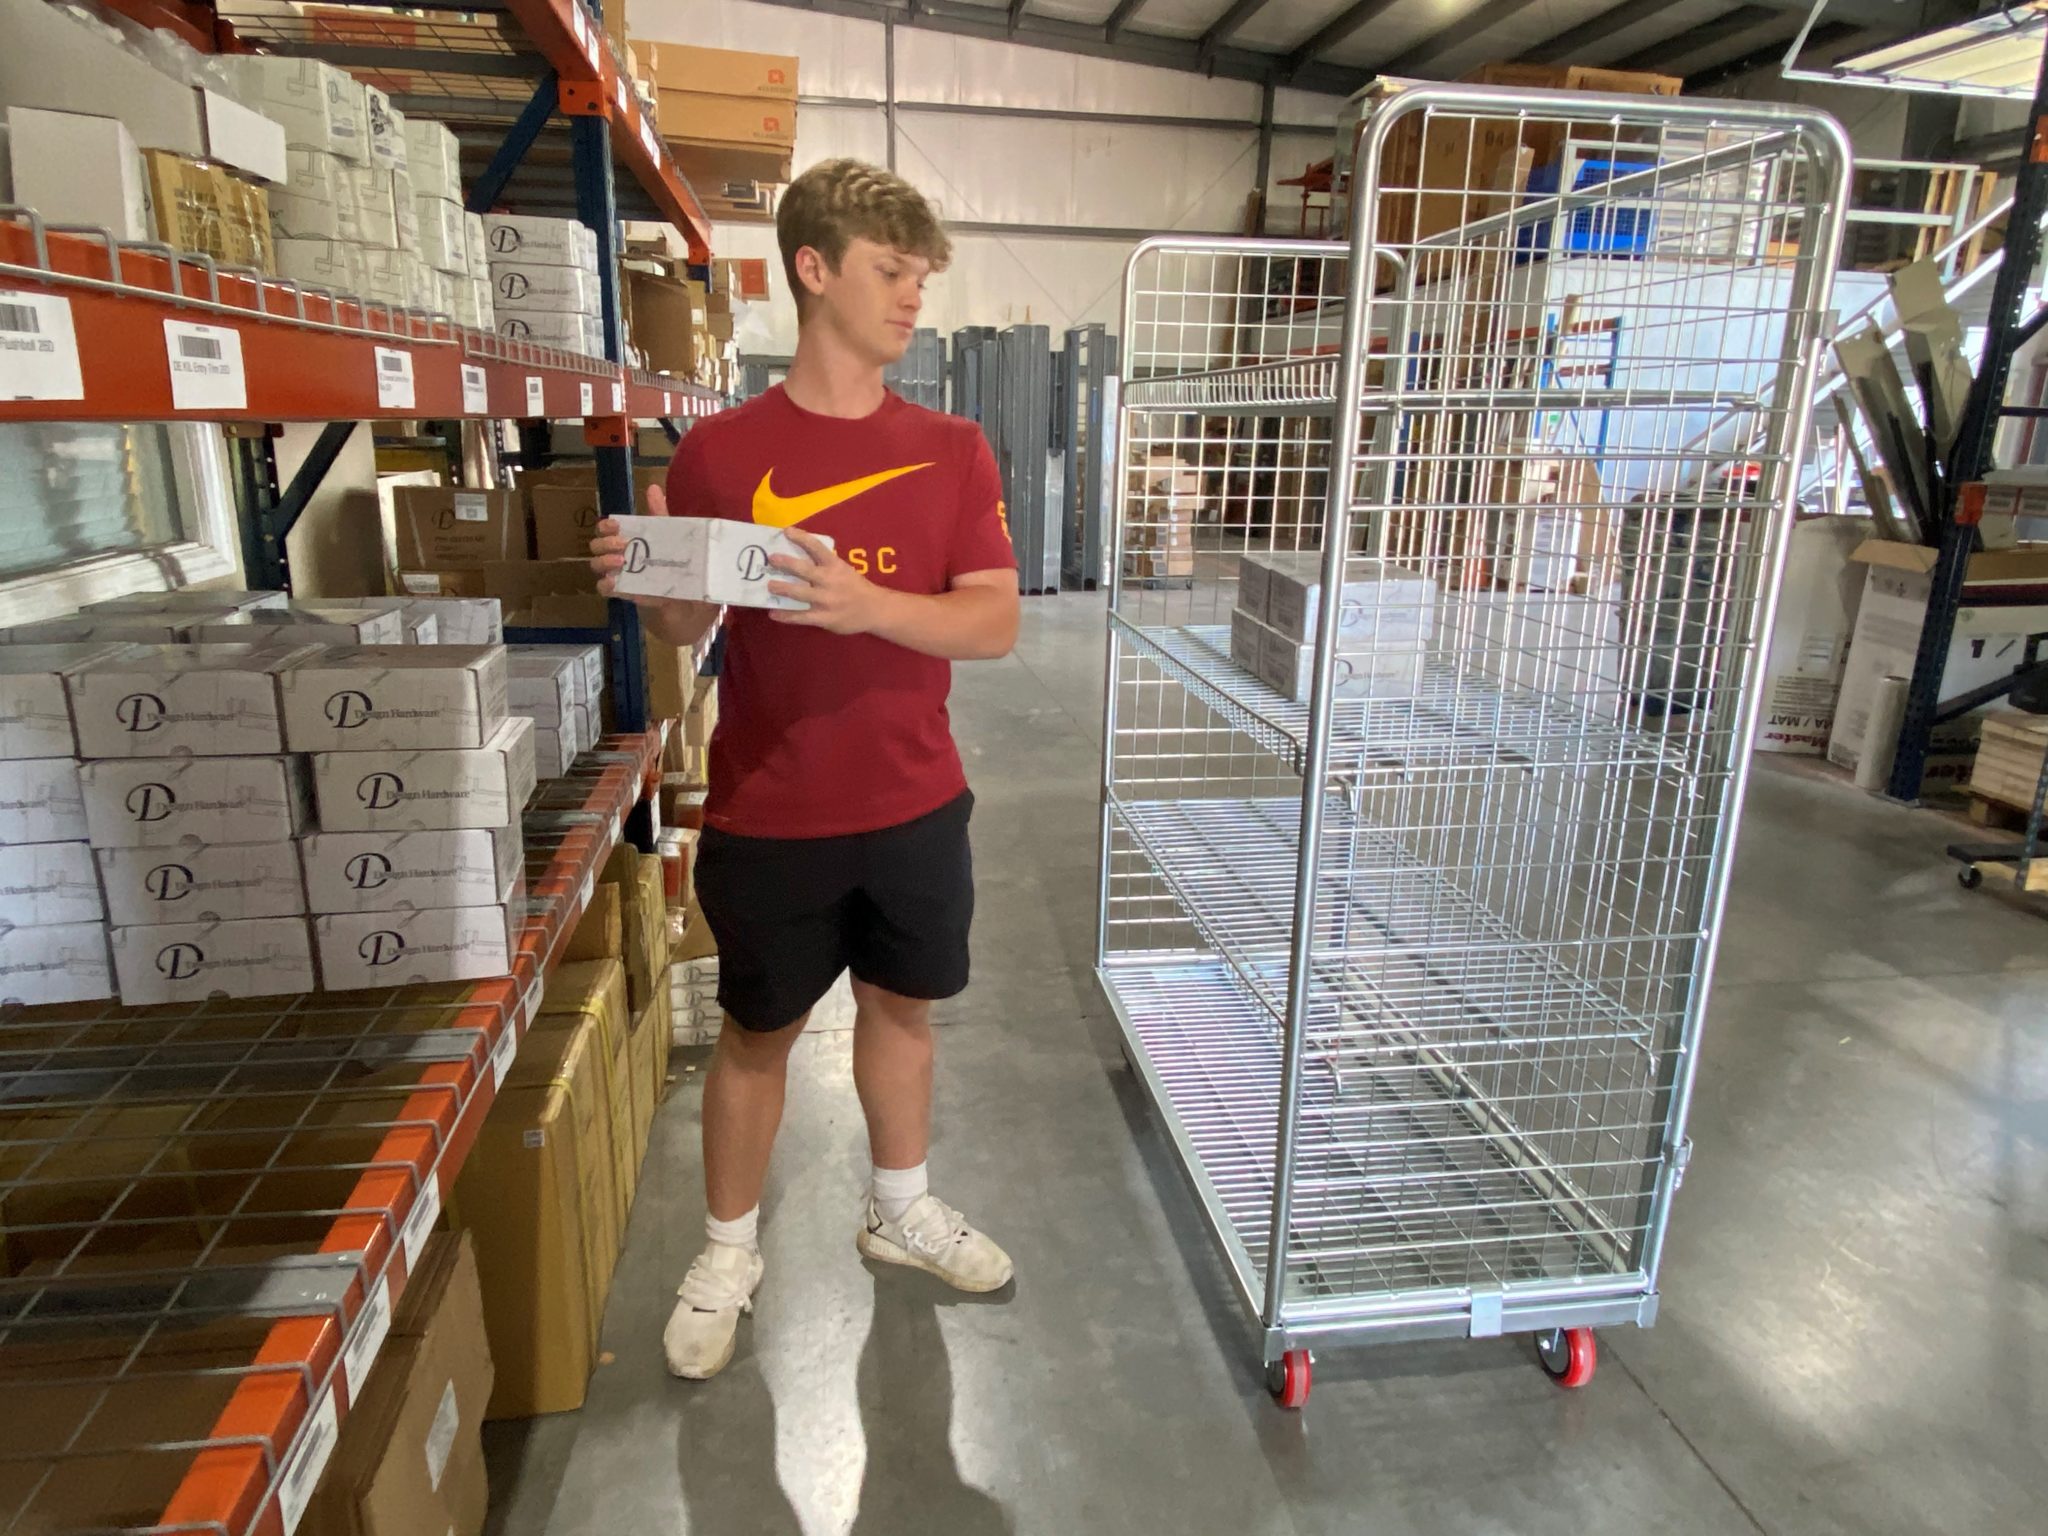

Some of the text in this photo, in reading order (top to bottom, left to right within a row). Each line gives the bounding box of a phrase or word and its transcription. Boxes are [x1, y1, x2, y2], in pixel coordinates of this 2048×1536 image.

[736, 544, 769, 582] D
[325, 690, 372, 728] D
[356, 772, 404, 809] D
[345, 852, 392, 889] D
[358, 930, 405, 966] D
